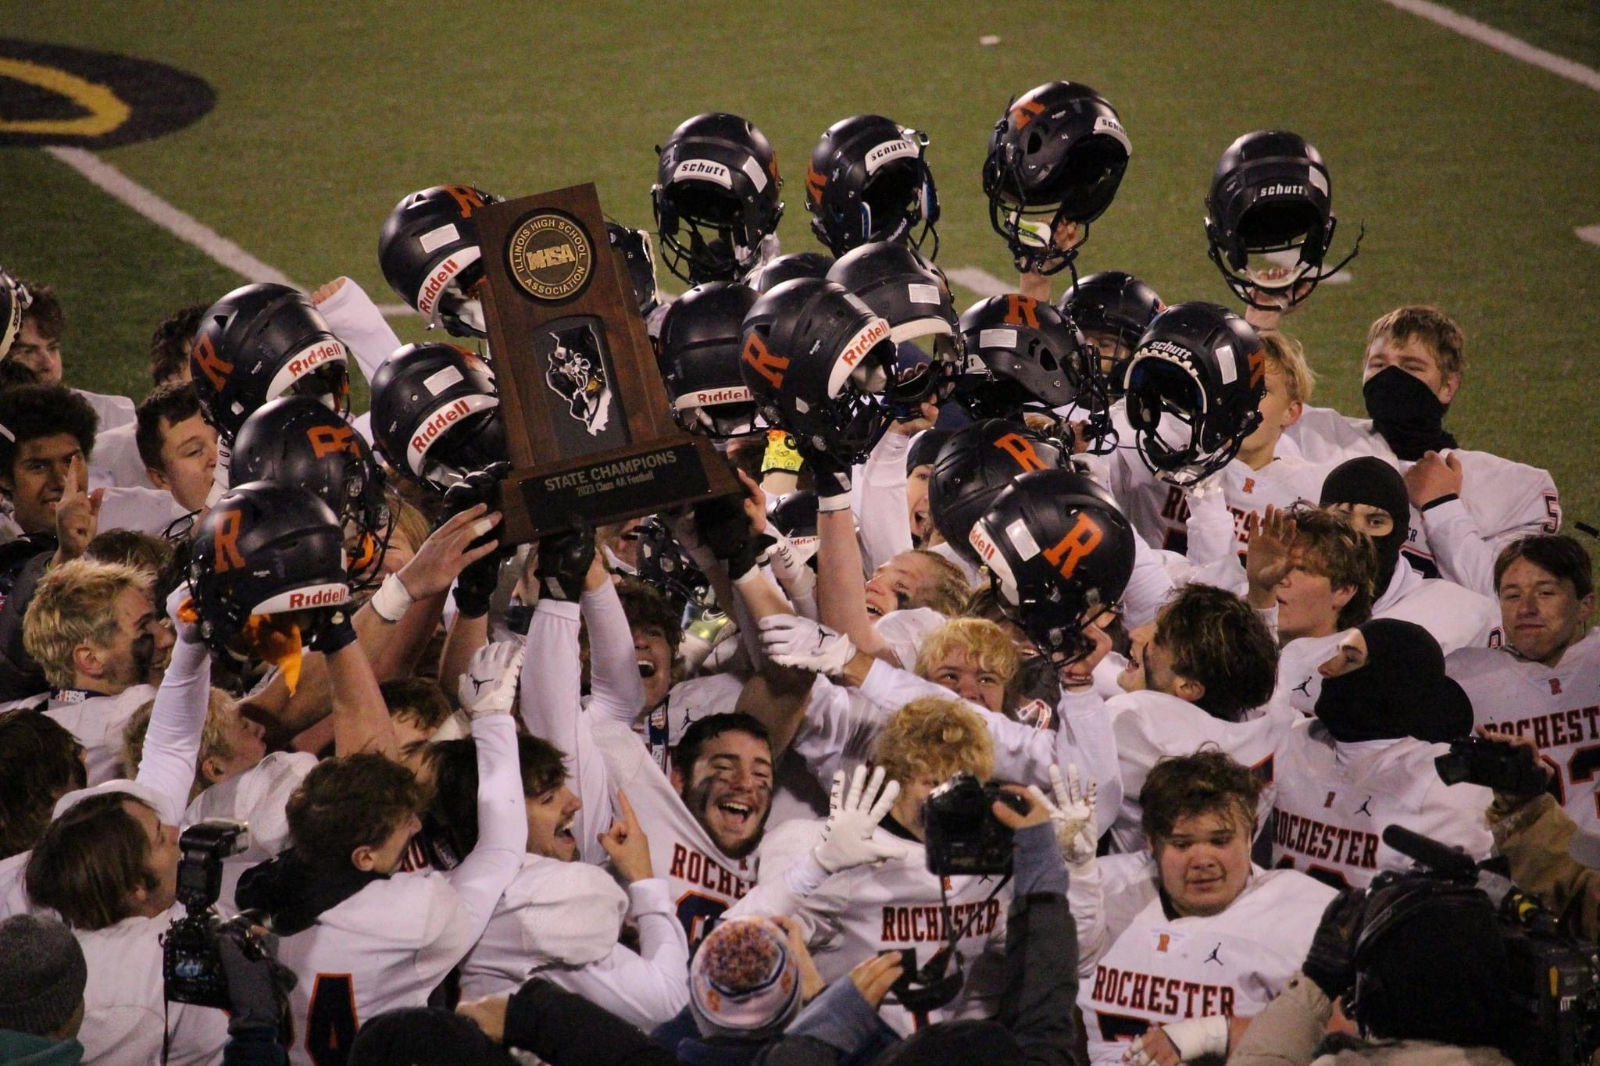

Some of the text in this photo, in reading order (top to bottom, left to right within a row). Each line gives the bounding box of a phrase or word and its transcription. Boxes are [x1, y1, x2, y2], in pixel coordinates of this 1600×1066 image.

[681, 162, 726, 176] schutt
[1260, 183, 1304, 197] schutt
[514, 219, 587, 273] ILLINOIS HIGH SCHOOL
[419, 259, 459, 315] Riddell
[524, 266, 586, 295] ASSOCIATION
[288, 343, 342, 377] Riddell
[742, 331, 790, 389] R
[842, 319, 888, 367] Riddell
[1149, 341, 1192, 360] schutt
[411, 399, 471, 454] Riddell
[544, 450, 677, 492] STATE CHAMPIONS
[214, 509, 247, 575] R
[1042, 512, 1104, 579] R
[289, 587, 346, 609] Riddell
[1272, 806, 1379, 870] ROCHESTER
[1091, 964, 1235, 1019] ROCHESTER
